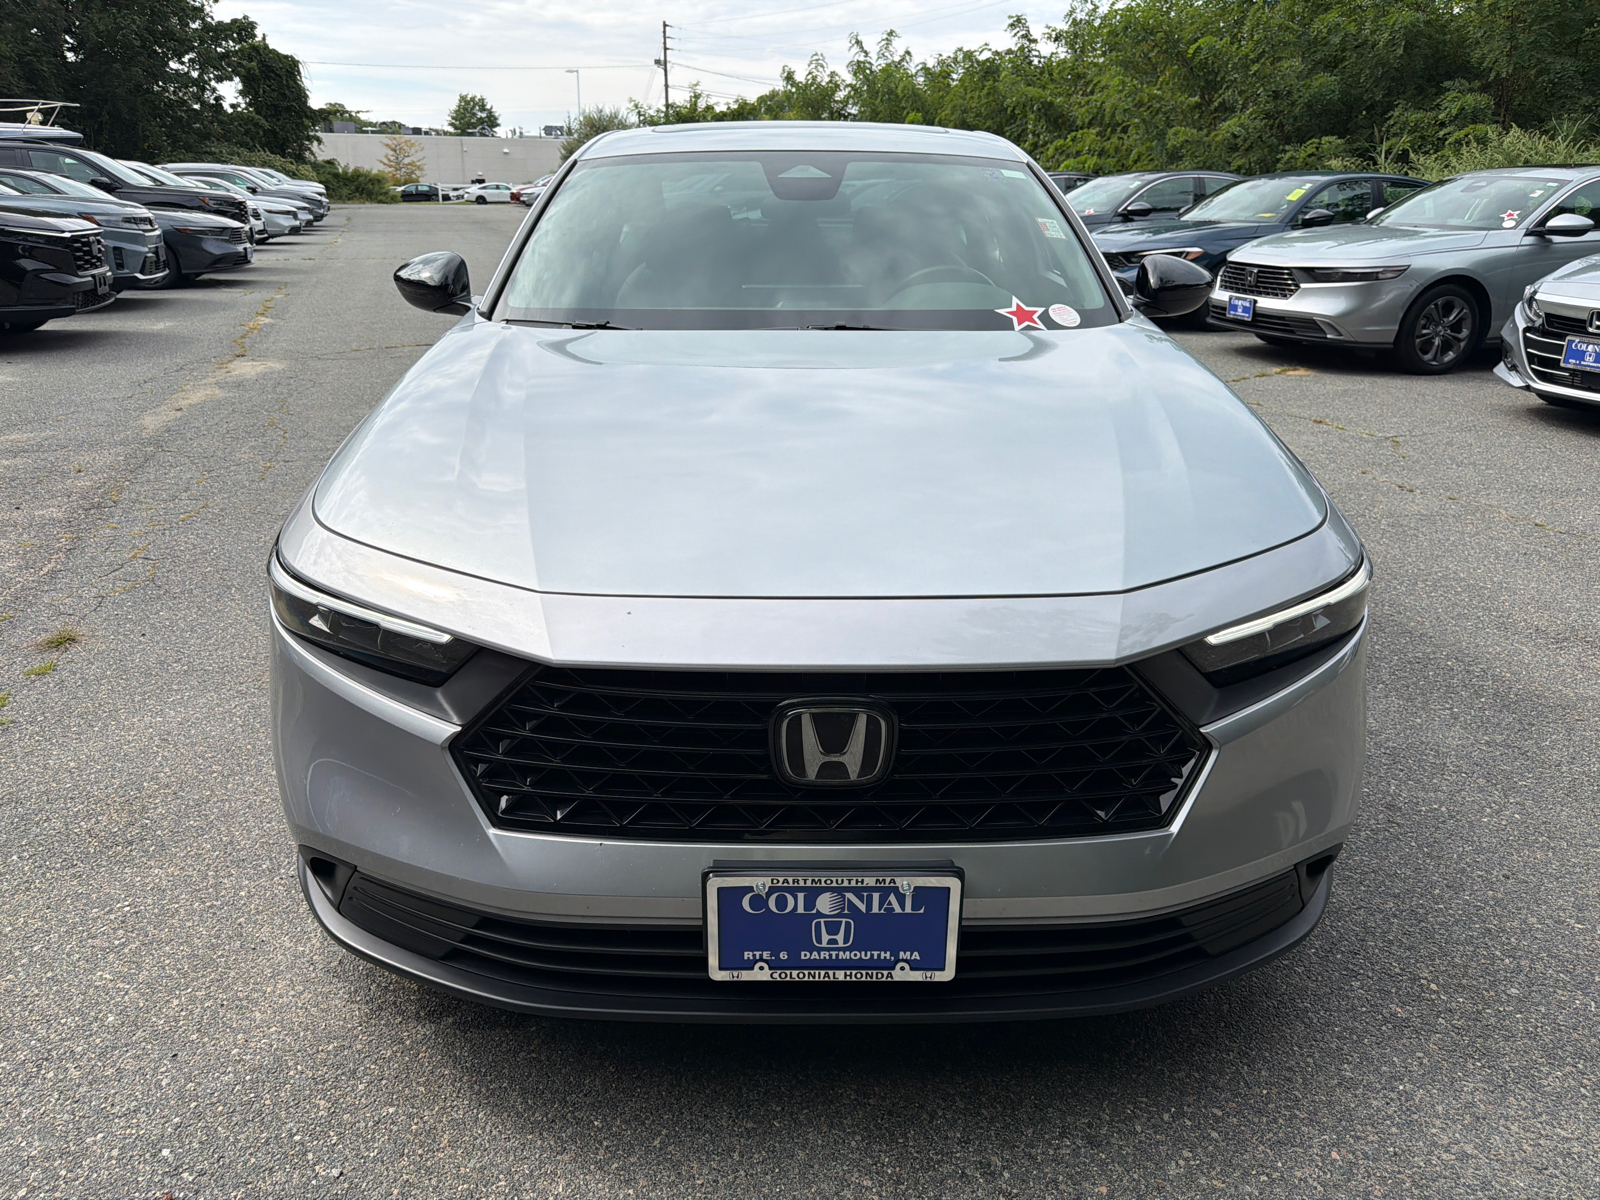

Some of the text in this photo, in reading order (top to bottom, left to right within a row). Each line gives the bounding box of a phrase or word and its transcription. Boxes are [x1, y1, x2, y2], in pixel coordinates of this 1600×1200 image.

[771, 878, 869, 886] DARTMOUTH,
[742, 892, 925, 915] COLONIAL
[744, 951, 921, 961] RTE. 6 DARTMOUTH, MA
[770, 971, 894, 980] COLONIAL HONDA
